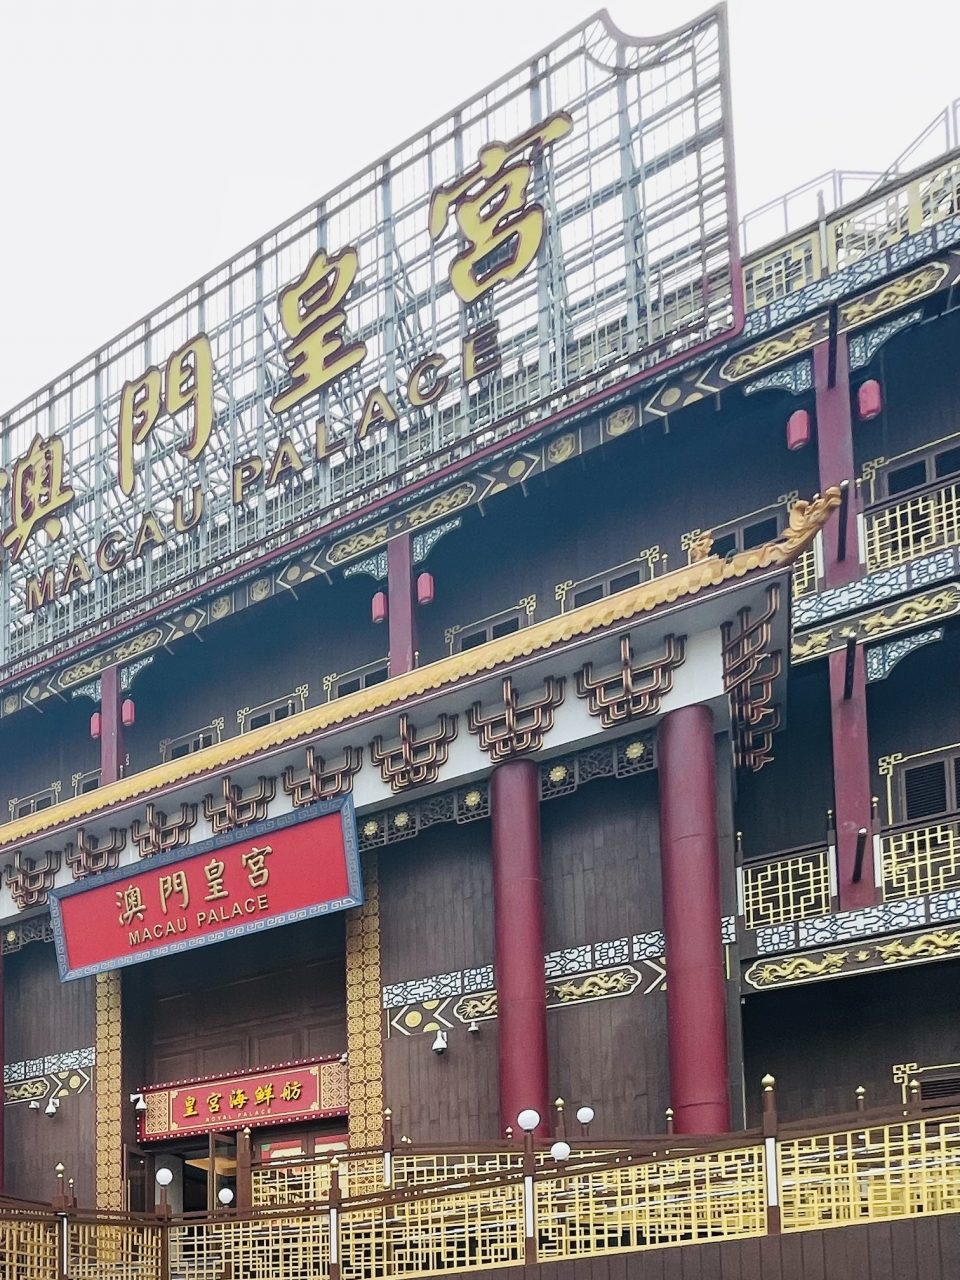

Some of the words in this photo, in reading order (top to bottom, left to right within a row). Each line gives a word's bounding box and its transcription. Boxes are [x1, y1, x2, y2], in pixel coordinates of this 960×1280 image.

[24, 486, 205, 613] MACAU
[232, 319, 503, 507] PALACE
[115, 845, 273, 927] 澳門皇宮
[128, 917, 188, 946] MACAU
[197, 894, 270, 928] PALACE
[182, 1081, 303, 1118] 皇宮海鮮舫
[205, 1114, 233, 1123] ROYAL
[237, 1108, 272, 1119] PALACE
